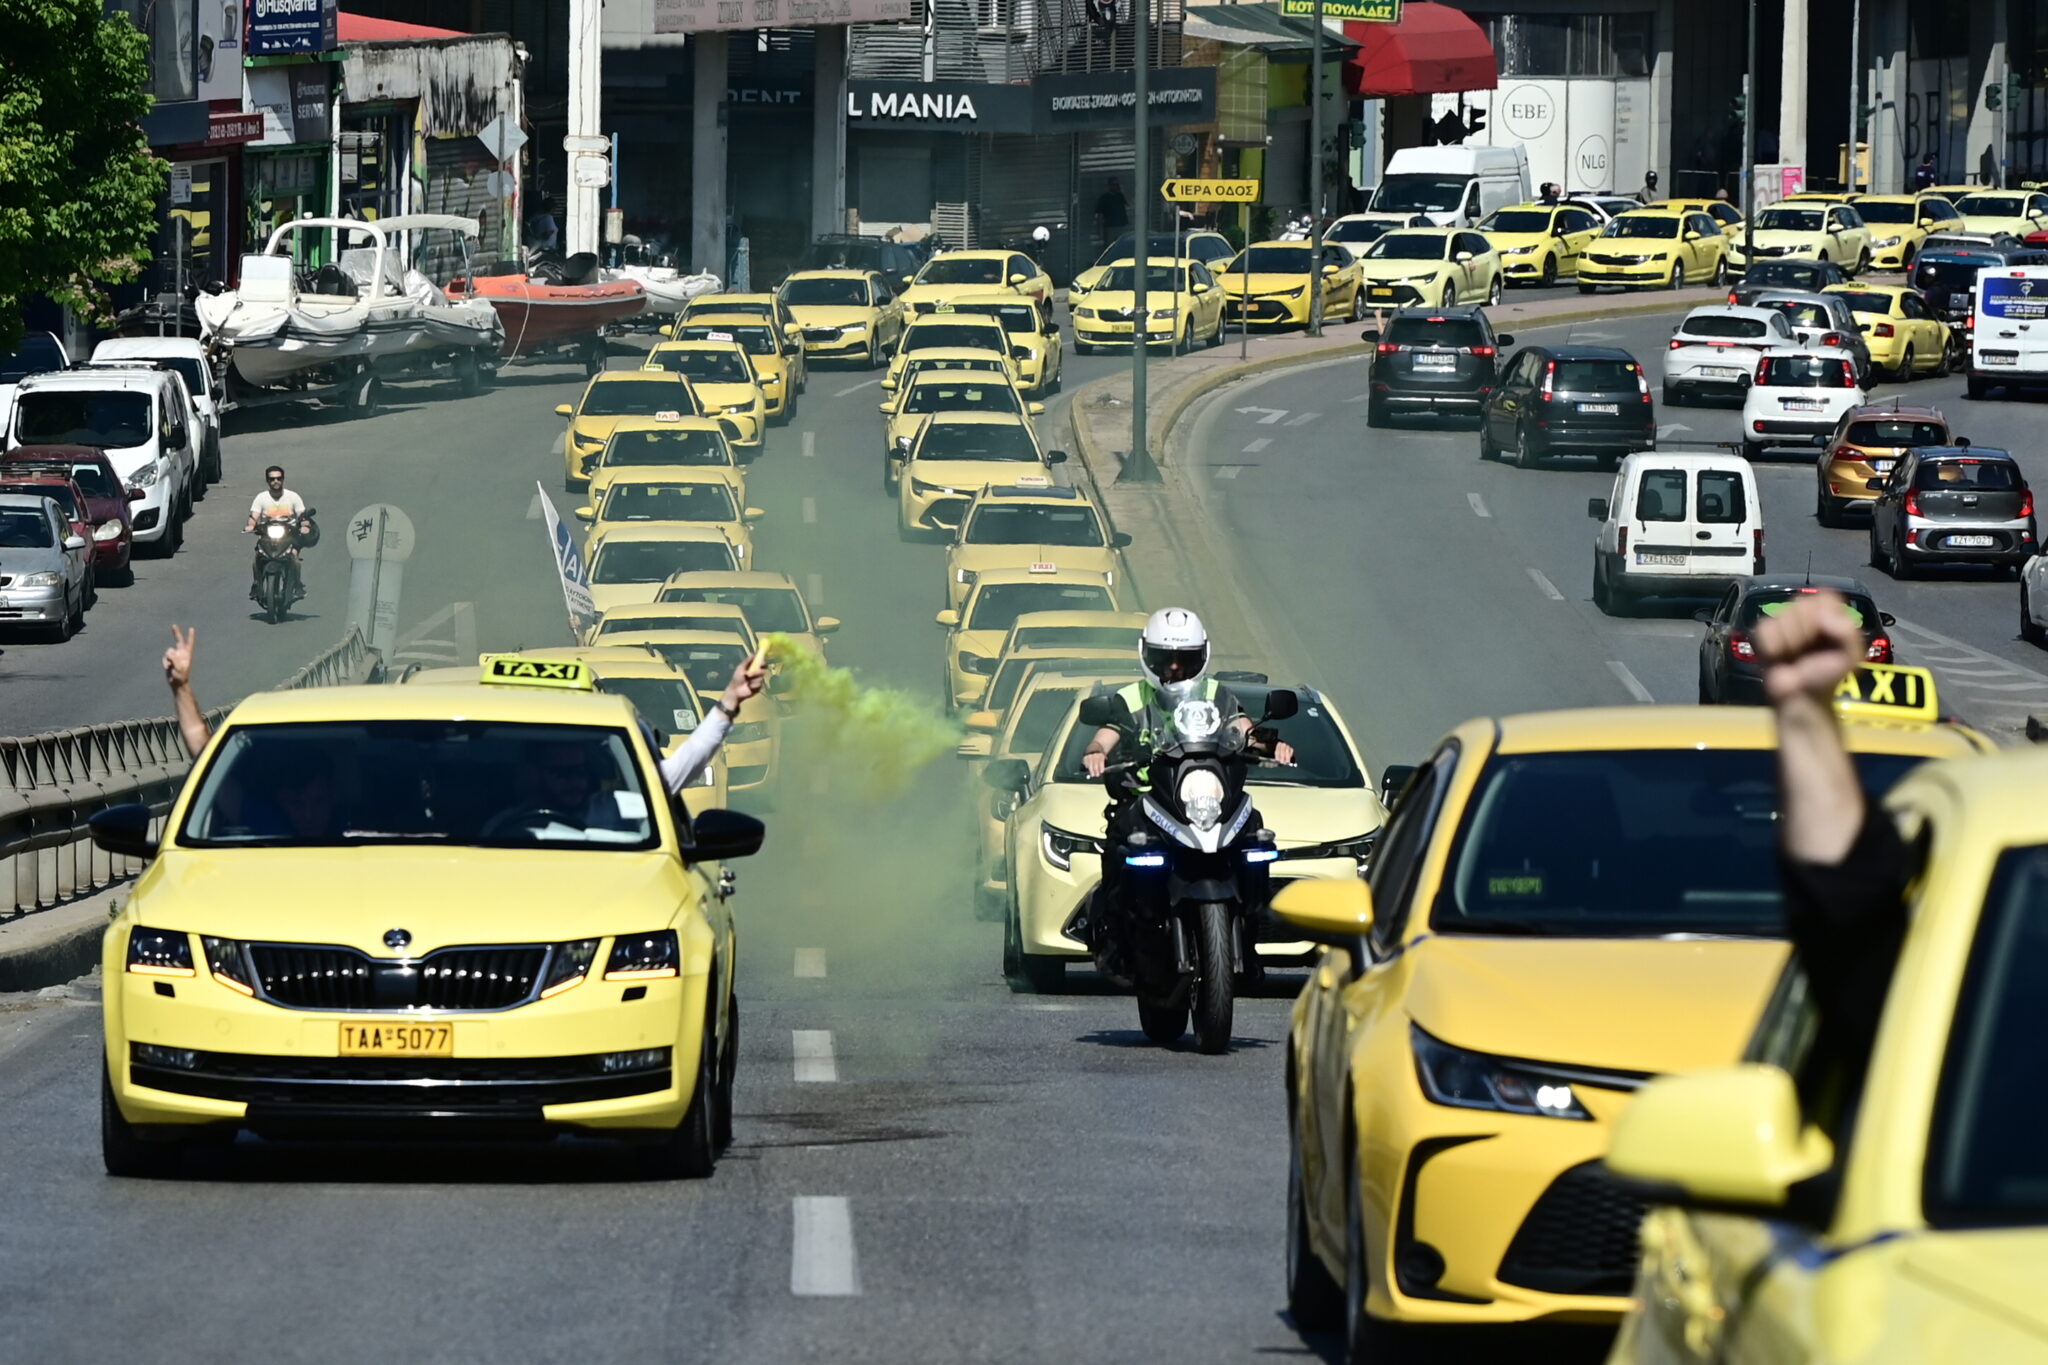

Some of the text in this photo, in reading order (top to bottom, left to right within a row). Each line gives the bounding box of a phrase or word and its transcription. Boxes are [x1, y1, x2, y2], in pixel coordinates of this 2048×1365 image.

[266, 0, 317, 15] Husqvarna
[1287, 2, 1392, 18] ΚΟΤΠΟΥΛΑΔΕΣ
[871, 92, 977, 119] MANIA
[1582, 154, 1606, 169] NLG
[1180, 184, 1253, 196] ΙΕΡΑ ΟΔΟΣ
[499, 662, 576, 678] TAXI
[1834, 670, 1917, 705] AXI
[1150, 810, 1181, 837] POLICE
